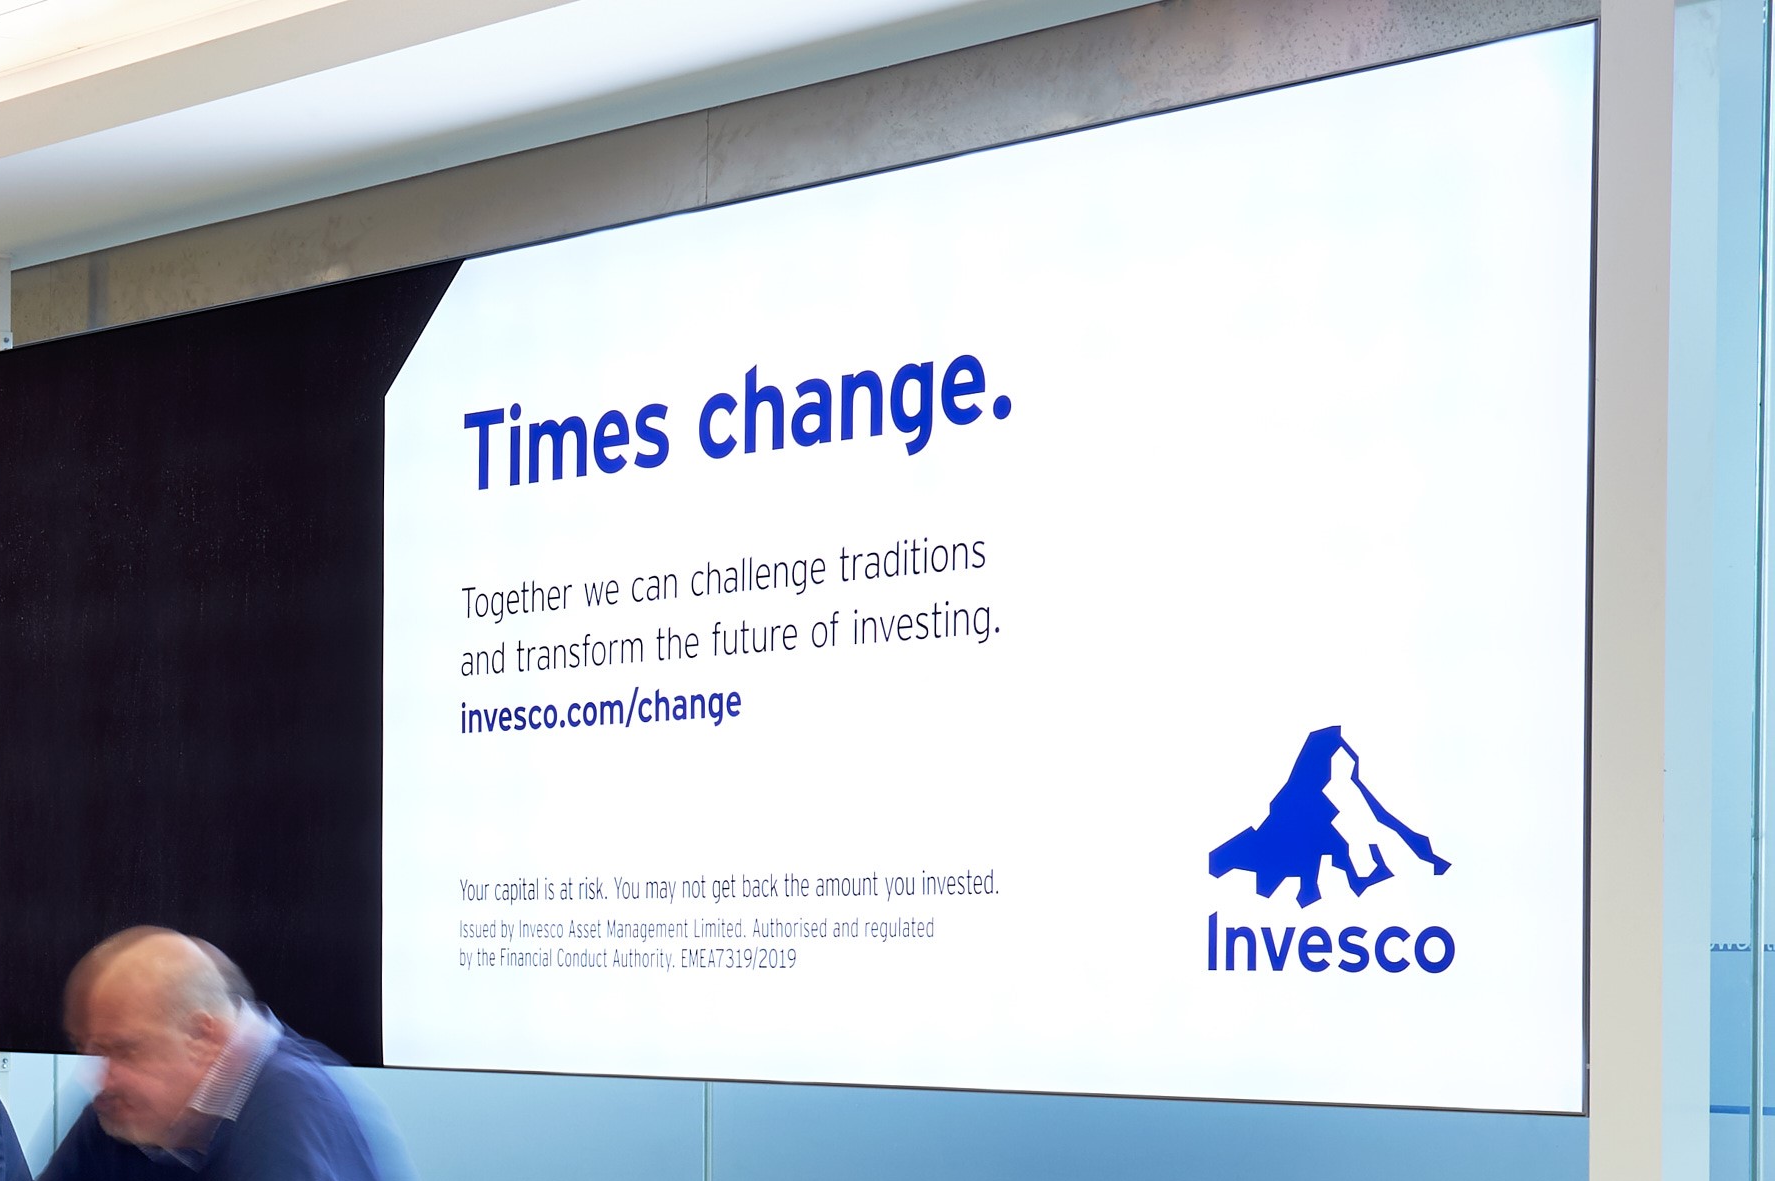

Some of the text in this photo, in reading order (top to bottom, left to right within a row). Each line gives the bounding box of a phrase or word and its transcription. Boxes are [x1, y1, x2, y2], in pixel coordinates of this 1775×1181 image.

[463, 354, 1012, 491] Times change.
[461, 537, 986, 625] Together we can challenge traditions
[461, 600, 1000, 677] and transform the future of investing.
[461, 686, 742, 734] invesco.com/change
[459, 868, 999, 906] Your capital is at risk. You may not get back the amount you invested.
[459, 917, 934, 943] Issued by Invesco Asset Management Limited. Authorised and regulated
[1207, 910, 1456, 974] Invesco
[459, 946, 797, 973] by the Financial Conduct Authority. EMEA7319/2019
